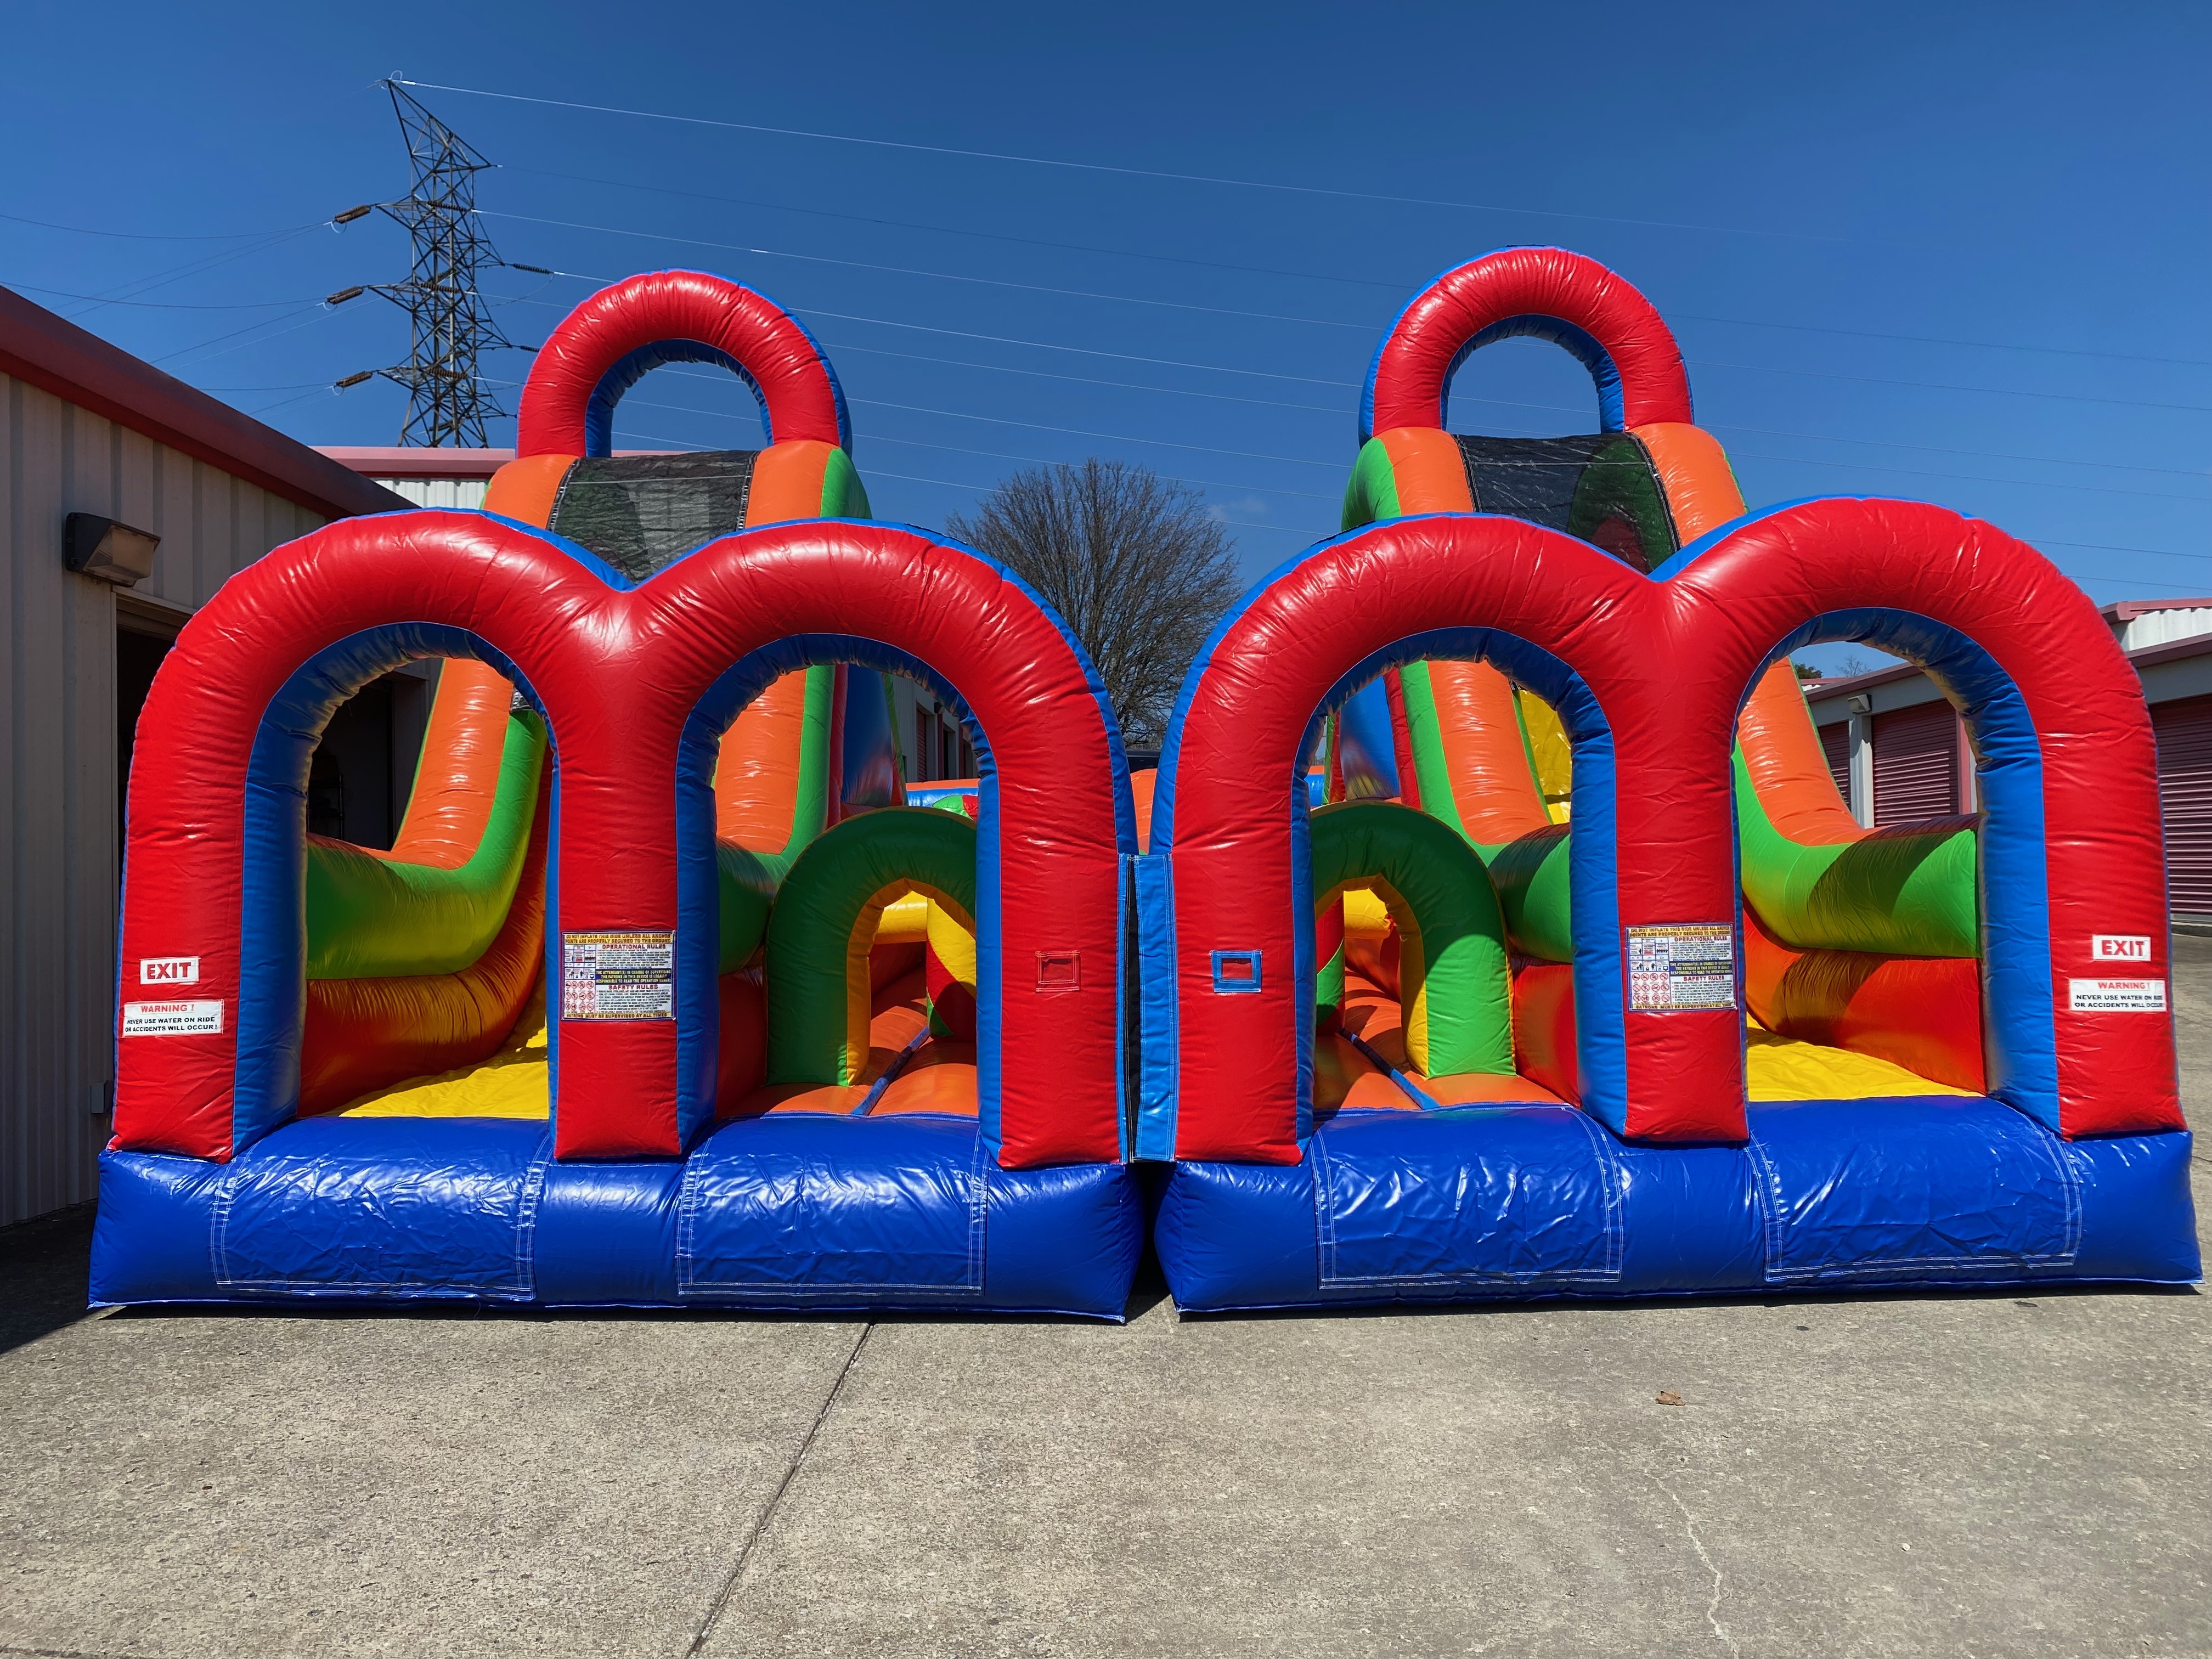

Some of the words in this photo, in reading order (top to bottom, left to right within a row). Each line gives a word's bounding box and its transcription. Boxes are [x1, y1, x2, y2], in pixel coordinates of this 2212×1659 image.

[2102, 940, 2145, 956] EXIT
[147, 962, 191, 979] EXIT
[141, 1005, 188, 1013] WARNING
